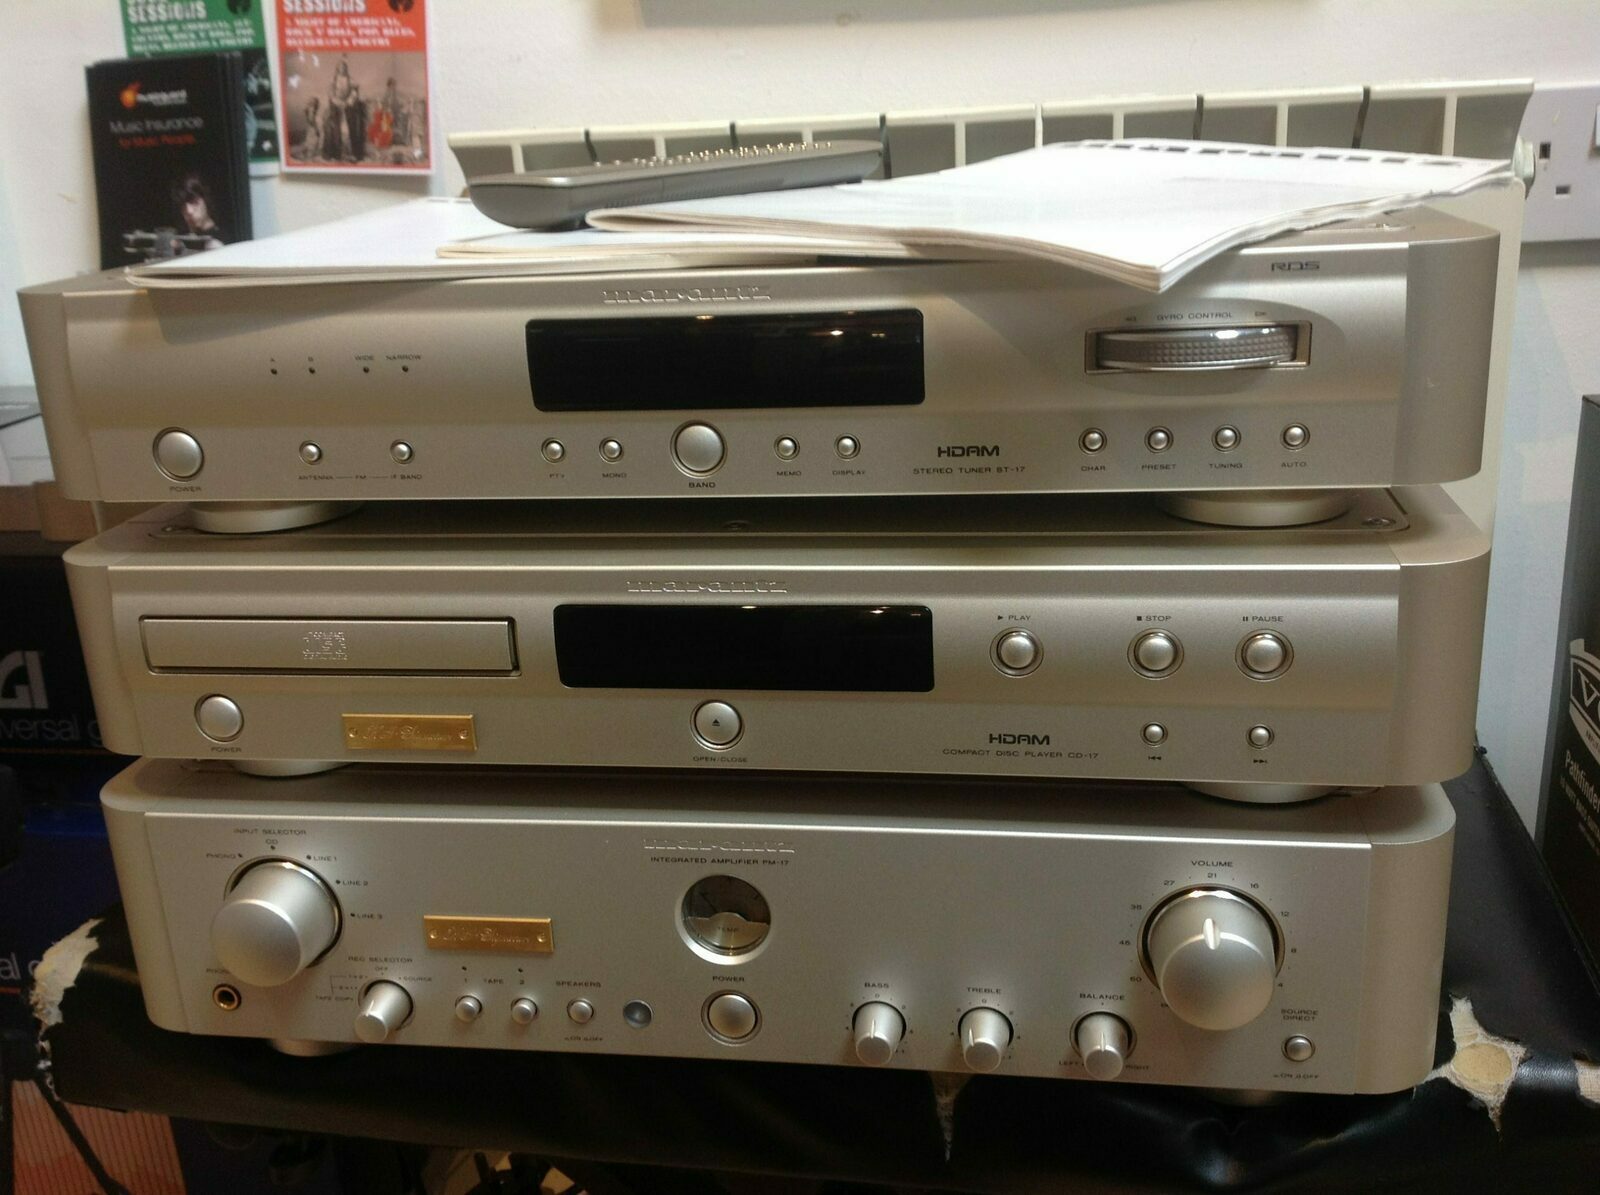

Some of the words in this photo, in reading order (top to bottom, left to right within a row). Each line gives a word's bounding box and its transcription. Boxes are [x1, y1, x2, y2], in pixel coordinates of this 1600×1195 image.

[1188, 312, 1234, 320] CONTROL
[937, 445, 1000, 458] HDAM
[912, 467, 954, 475] STEREO
[958, 466, 992, 474] TUNER
[1141, 463, 1177, 471] PRESET
[988, 733, 1051, 746] HDAM
[942, 748, 990, 756] COMPACT
[692, 755, 748, 763] OPEN/CLOSE
[650, 856, 708, 864] INTEGRATED
[711, 857, 759, 865] AMPLIFIER
[1191, 860, 1234, 868] VOLUME
[342, 879, 362, 887] LINE
[966, 987, 1002, 995] TREBLE
[1079, 993, 1126, 1001] BALANCE
